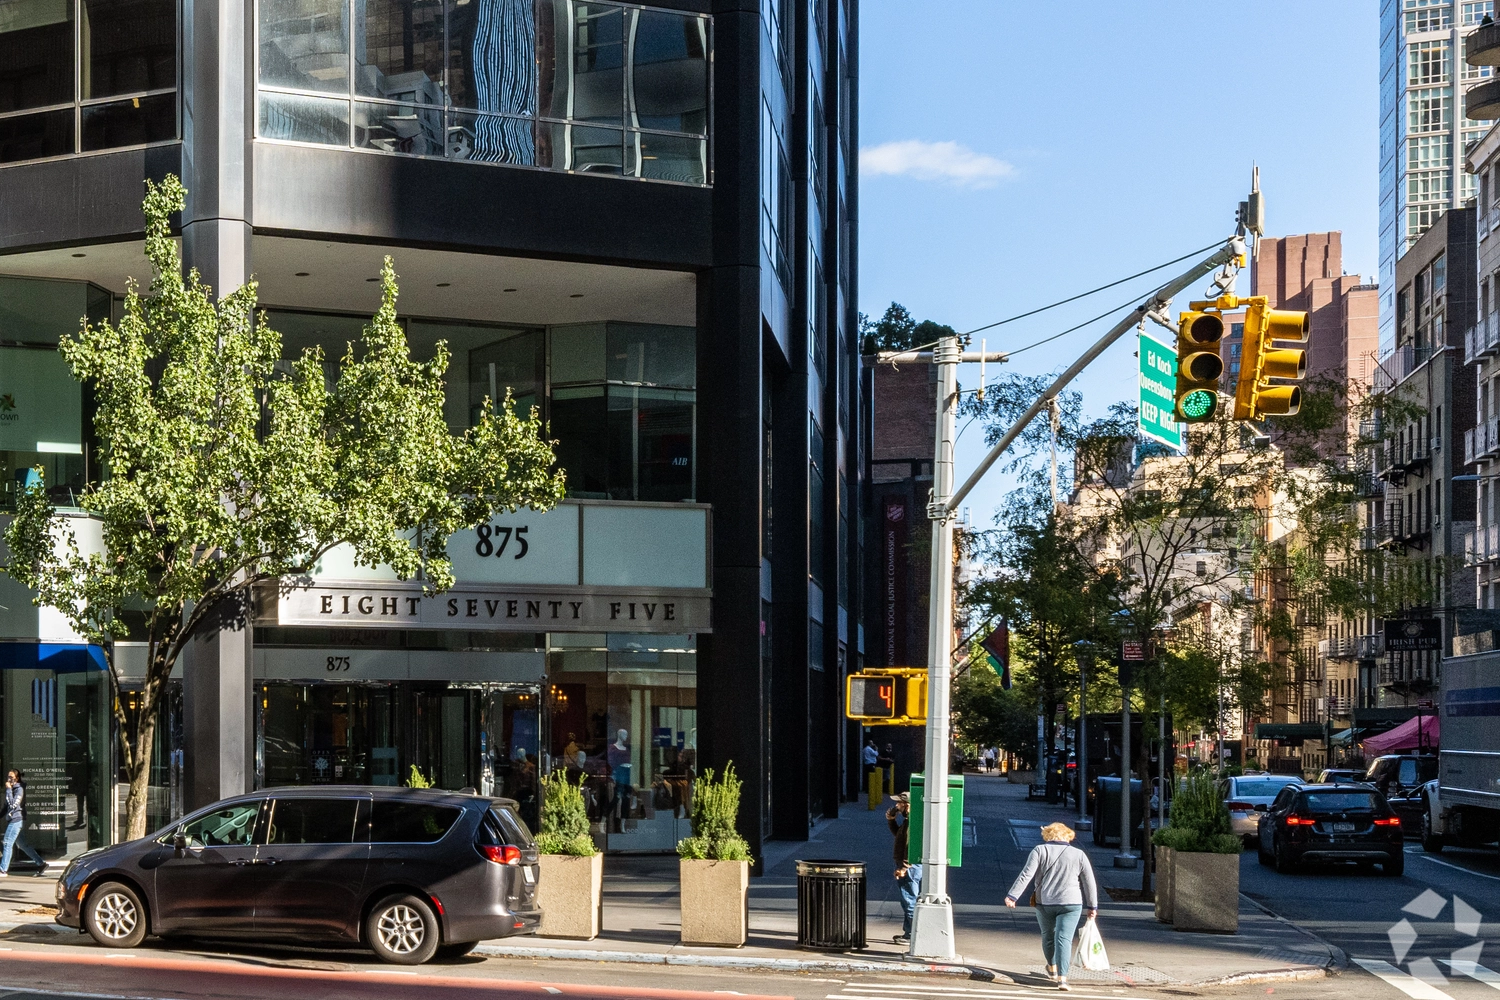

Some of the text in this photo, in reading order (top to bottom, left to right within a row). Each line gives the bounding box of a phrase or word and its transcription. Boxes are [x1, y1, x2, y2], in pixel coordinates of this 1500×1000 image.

[1147, 350, 1172, 377] Ed Koch
[1140, 371, 1172, 402] Queensboro
[1142, 400, 1158, 424] KEEP
[672, 457, 688, 466] AIB
[475, 524, 529, 560] 875
[888, 577, 896, 601] JUSTICE
[320, 595, 676, 621] EIGHT SEVENTY FIVE
[1389, 637, 1437, 646] IRISH PUB
[326, 656, 350, 672] 875
[879, 685, 891, 709] 4
